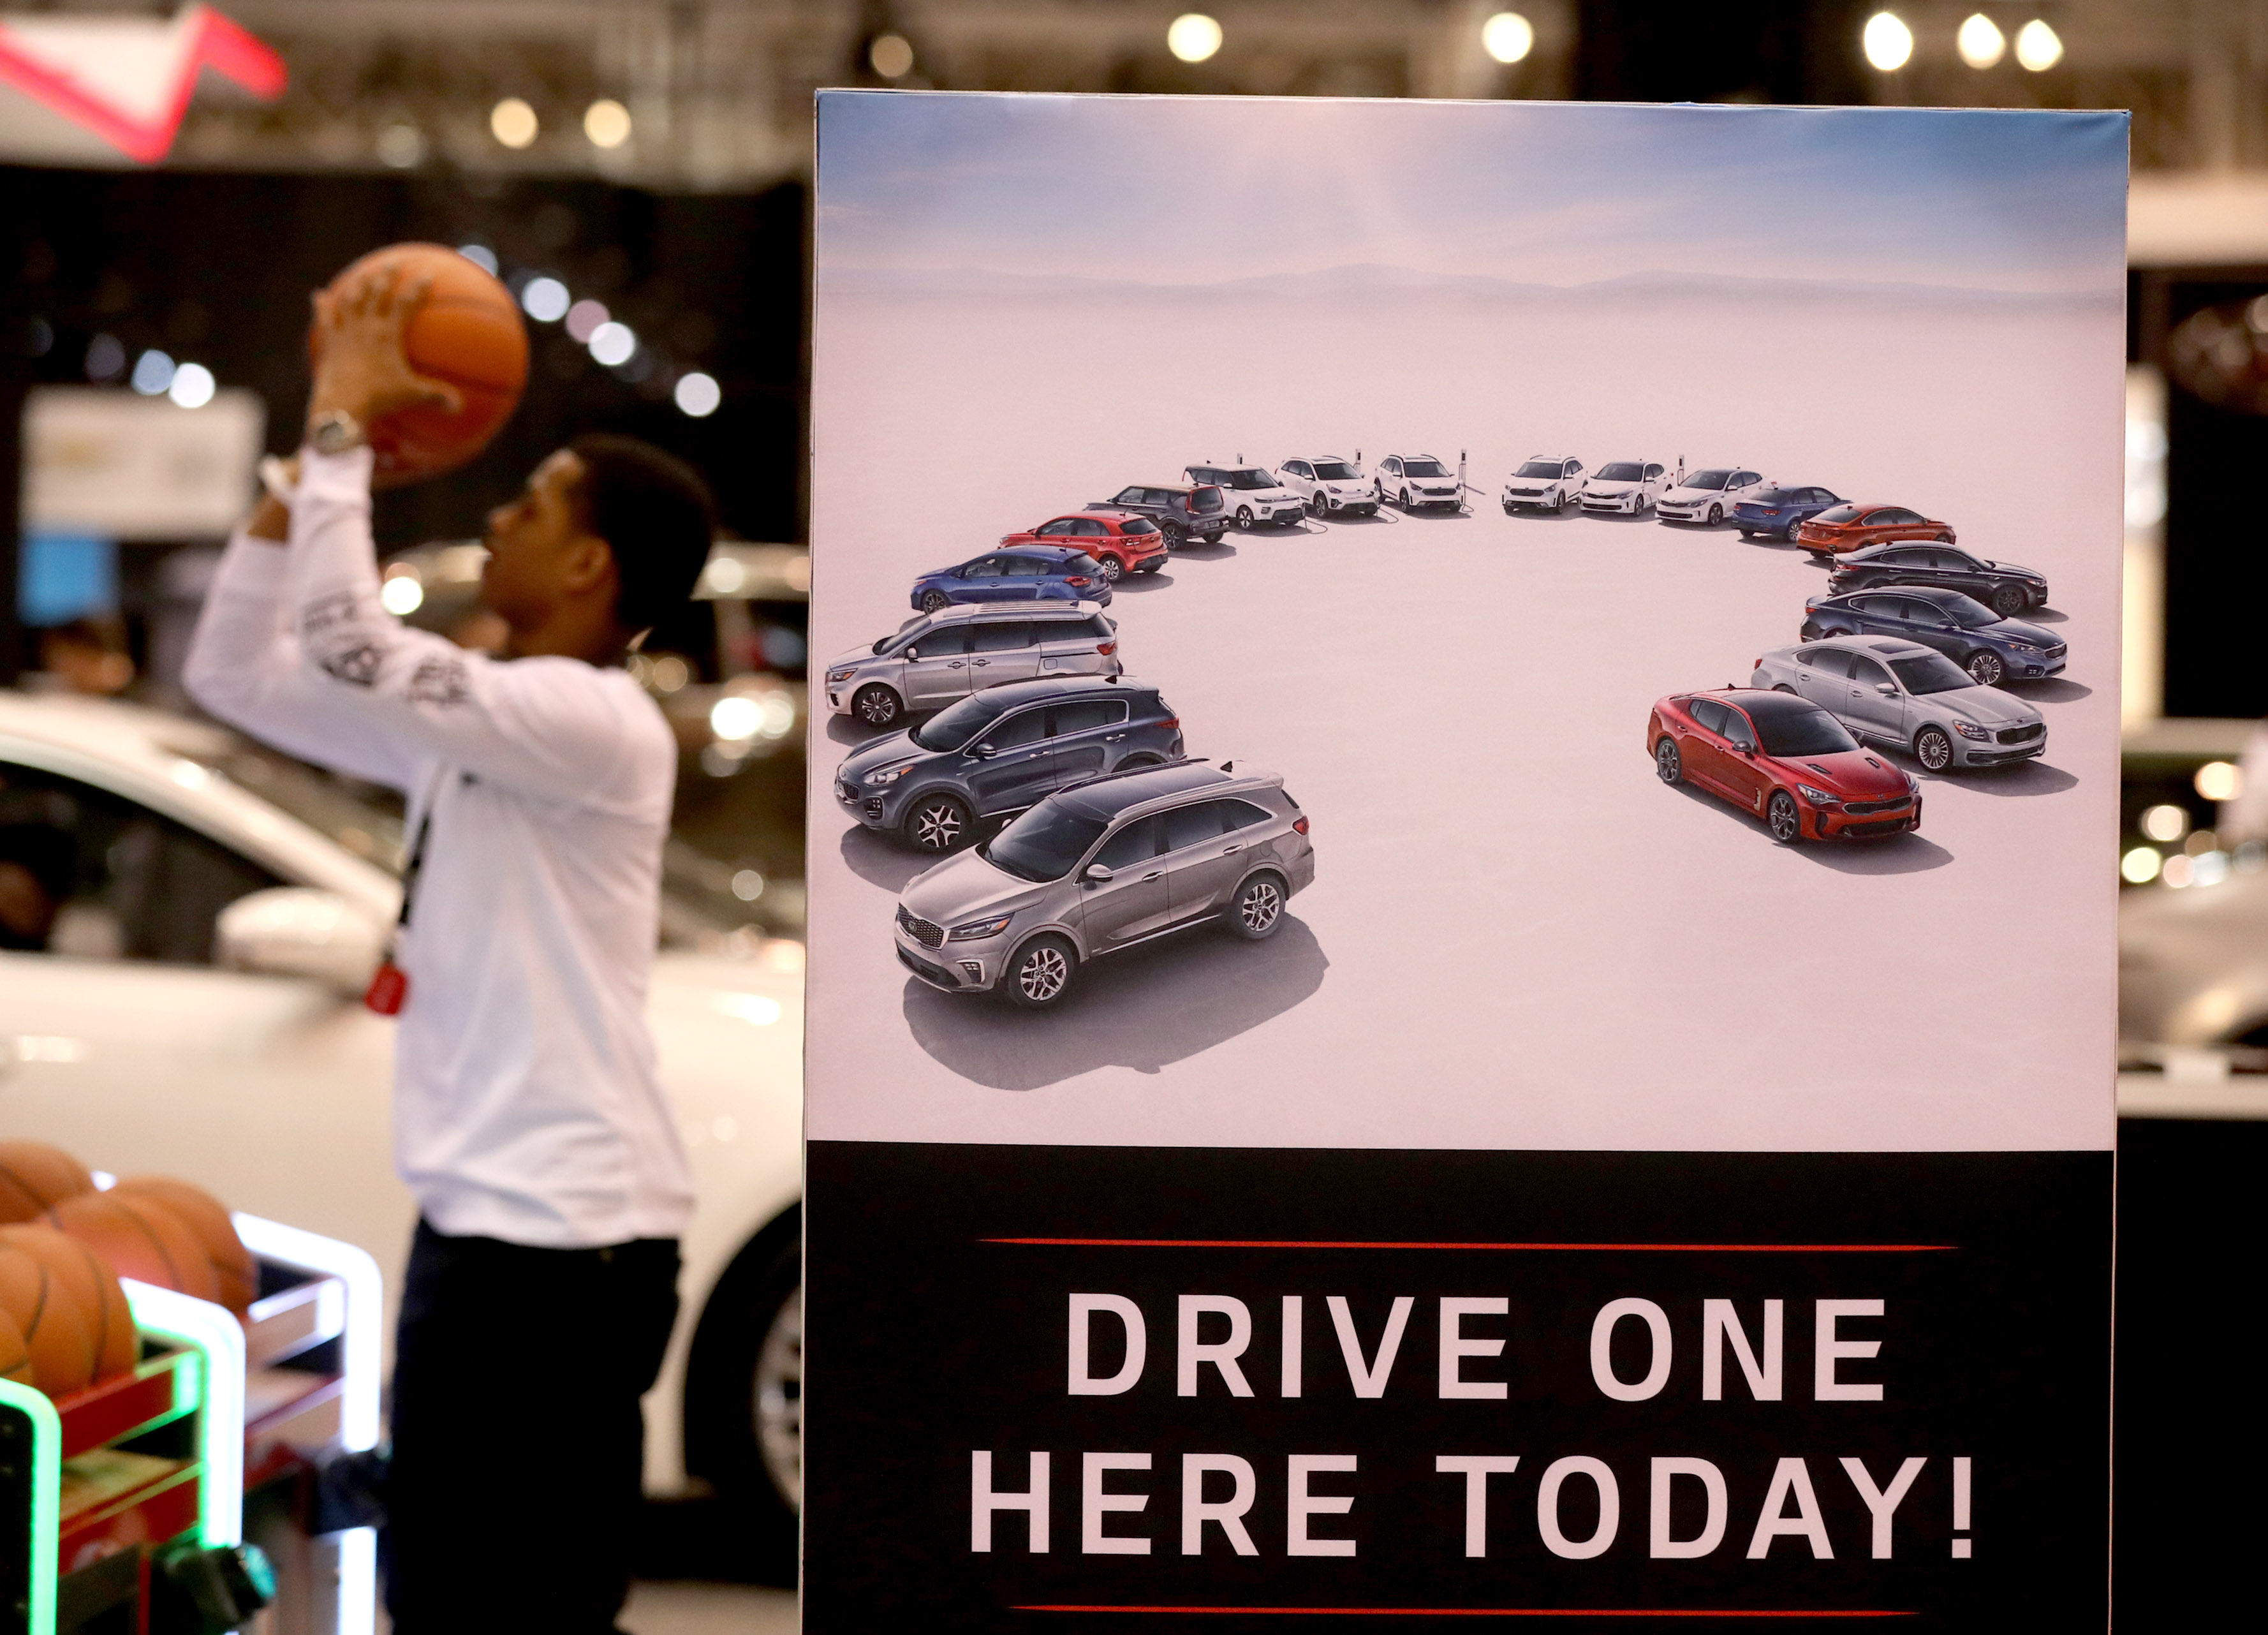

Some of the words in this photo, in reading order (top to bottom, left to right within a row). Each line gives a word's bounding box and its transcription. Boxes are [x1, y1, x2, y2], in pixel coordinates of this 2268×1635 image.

[1067, 1293, 1510, 1400] DRIVE
[1589, 1297, 1886, 1402] ONE
[971, 1450, 1359, 1557] HERE
[1435, 1455, 1973, 1560] TODAY!
